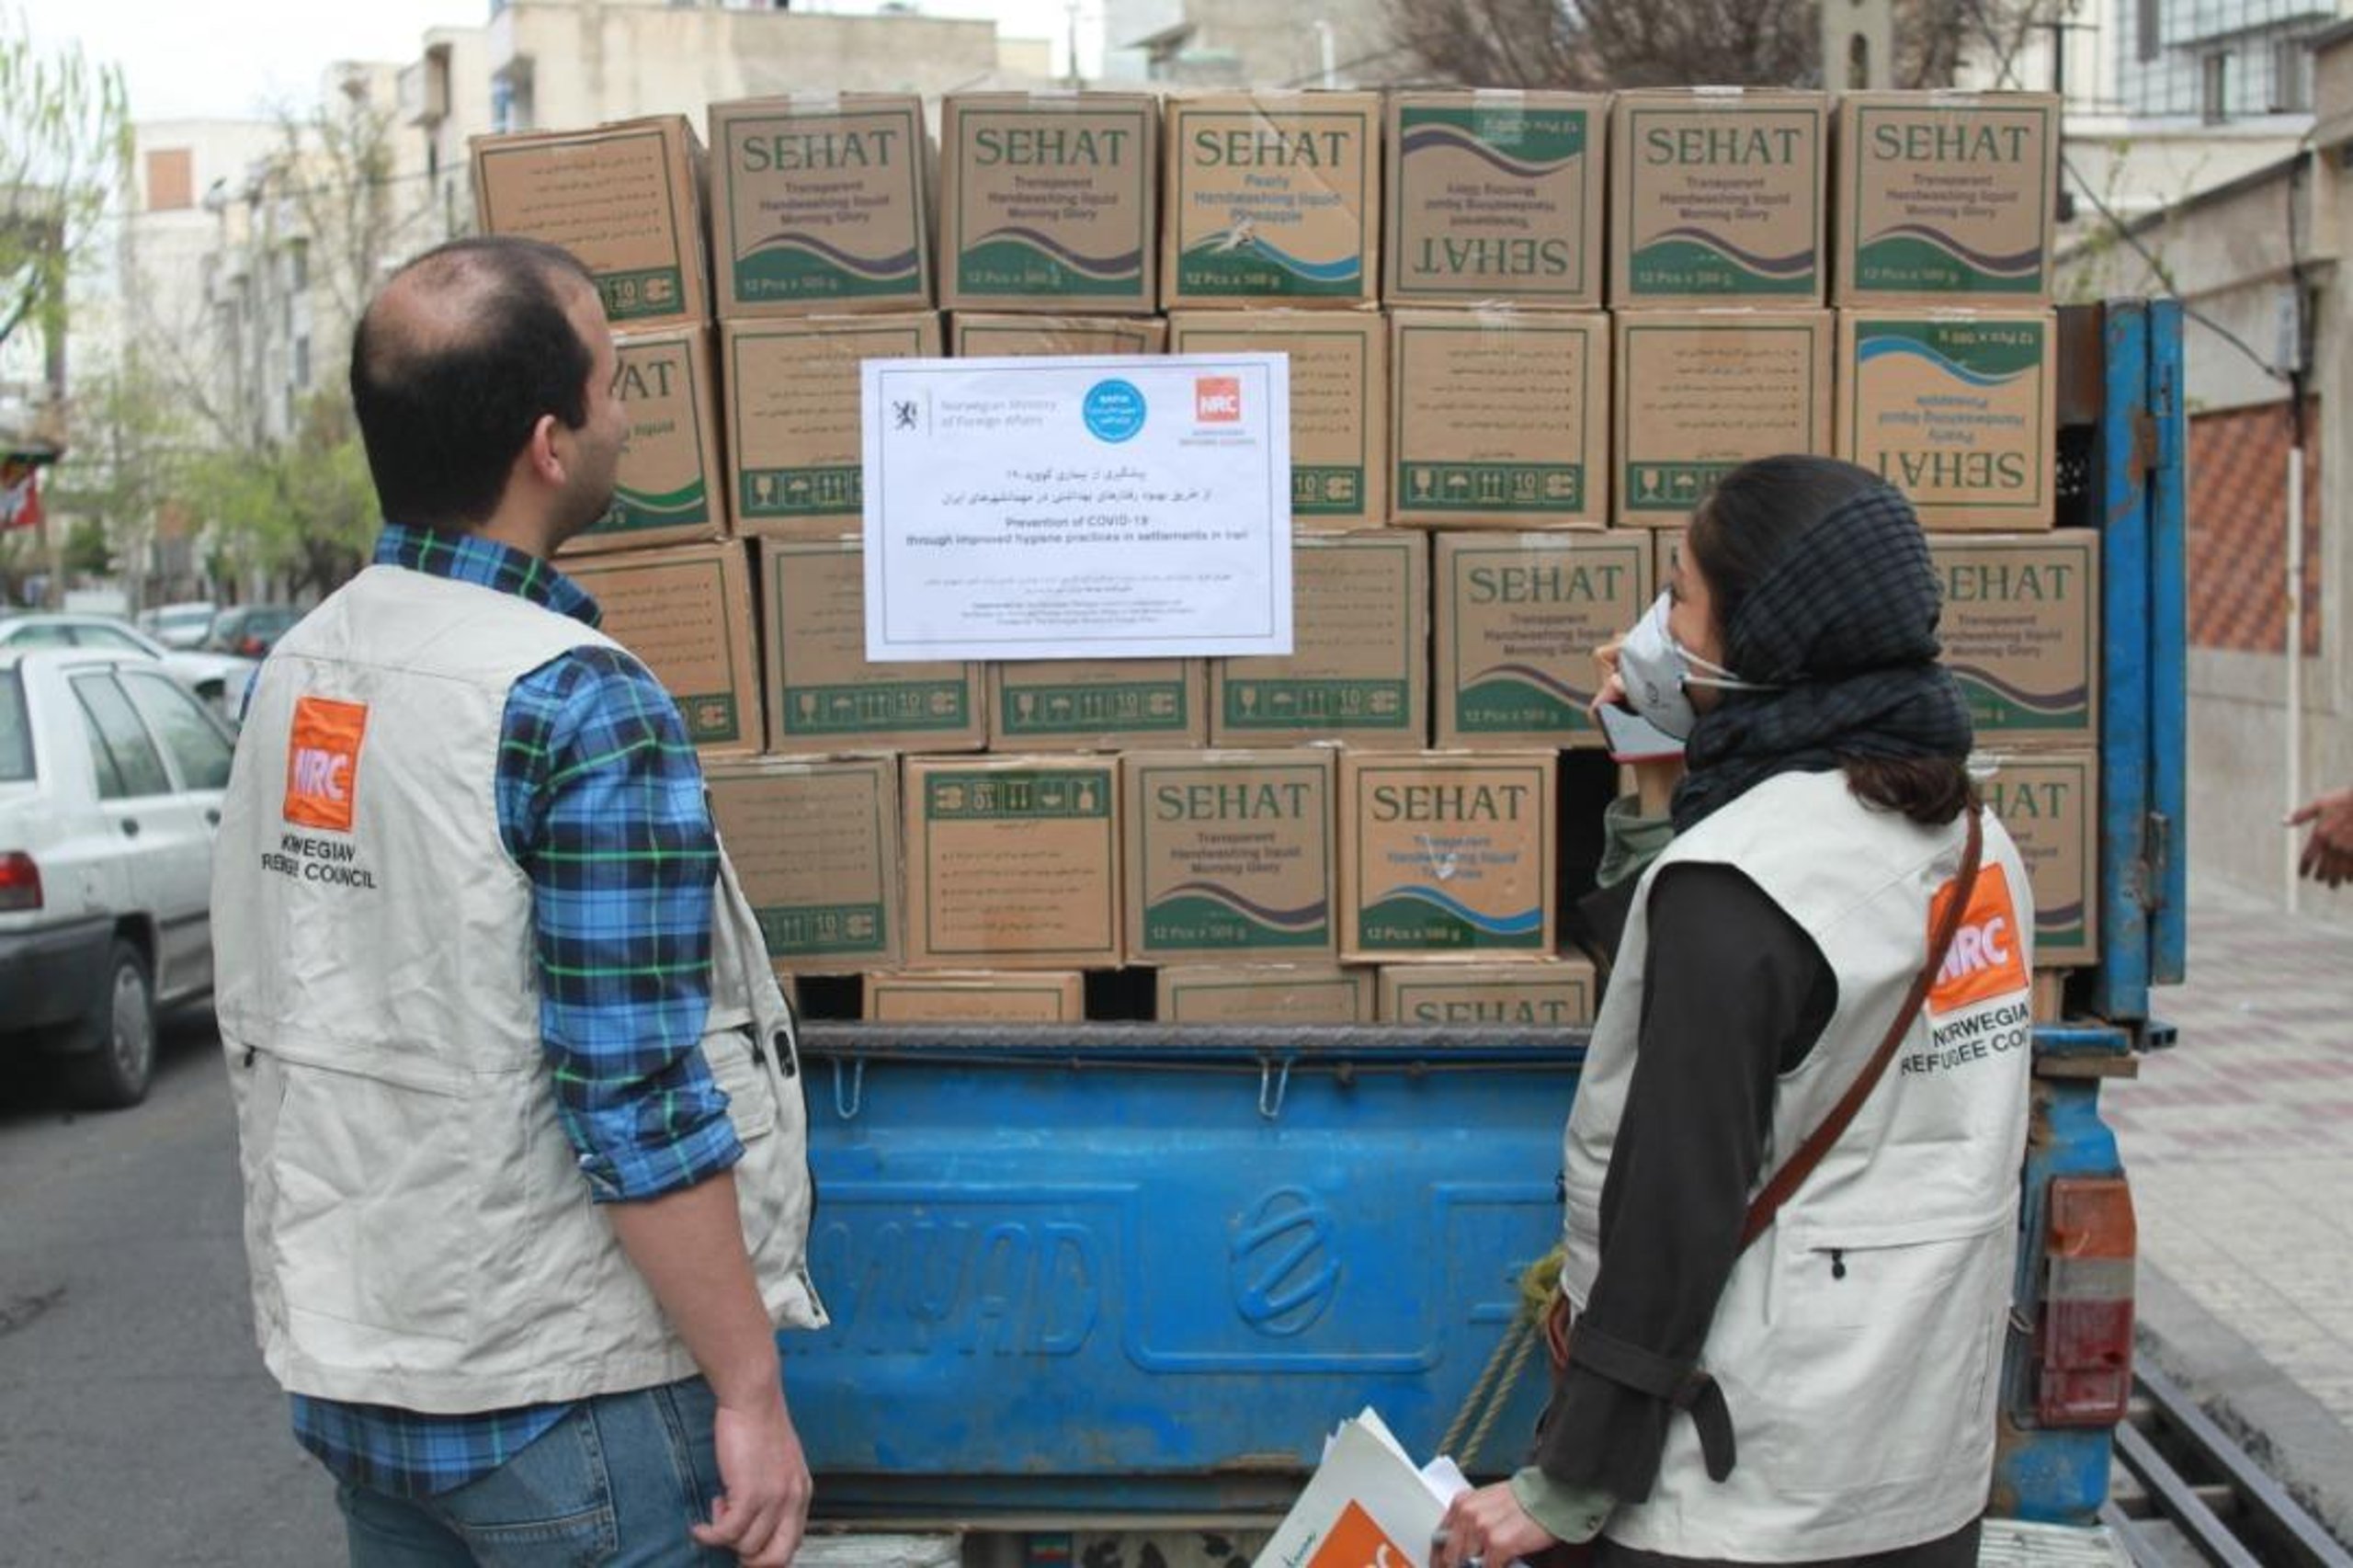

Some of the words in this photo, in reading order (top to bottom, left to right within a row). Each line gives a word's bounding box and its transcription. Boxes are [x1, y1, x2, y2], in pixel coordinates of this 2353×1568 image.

[742, 130, 897, 173] SEHAT
[974, 129, 1129, 166] SEHAT
[1194, 130, 1350, 167] SEHAT
[1646, 129, 1802, 165] SEHAT
[1874, 124, 2029, 162] SEHAT
[1413, 238, 1569, 275] SEHAT
[1199, 394, 1237, 415] NRC
[905, 533, 953, 548] through
[956, 533, 1011, 547] improved
[1015, 532, 1061, 547] hygiene
[1064, 531, 1120, 544] practices
[1006, 517, 1069, 528] Prevention
[1072, 516, 1085, 527] of
[1468, 565, 1622, 604] SEHAT
[1949, 564, 2073, 602] EHAT
[1156, 783, 1311, 821] SEHAT
[1372, 785, 1529, 823] SEHAT
[304, 862, 377, 889] COUNCIL
[1936, 916, 2008, 985] NRC
[1933, 1003, 2029, 1048] NORWEGIA
[1901, 1040, 1988, 1076] REFUGEE
